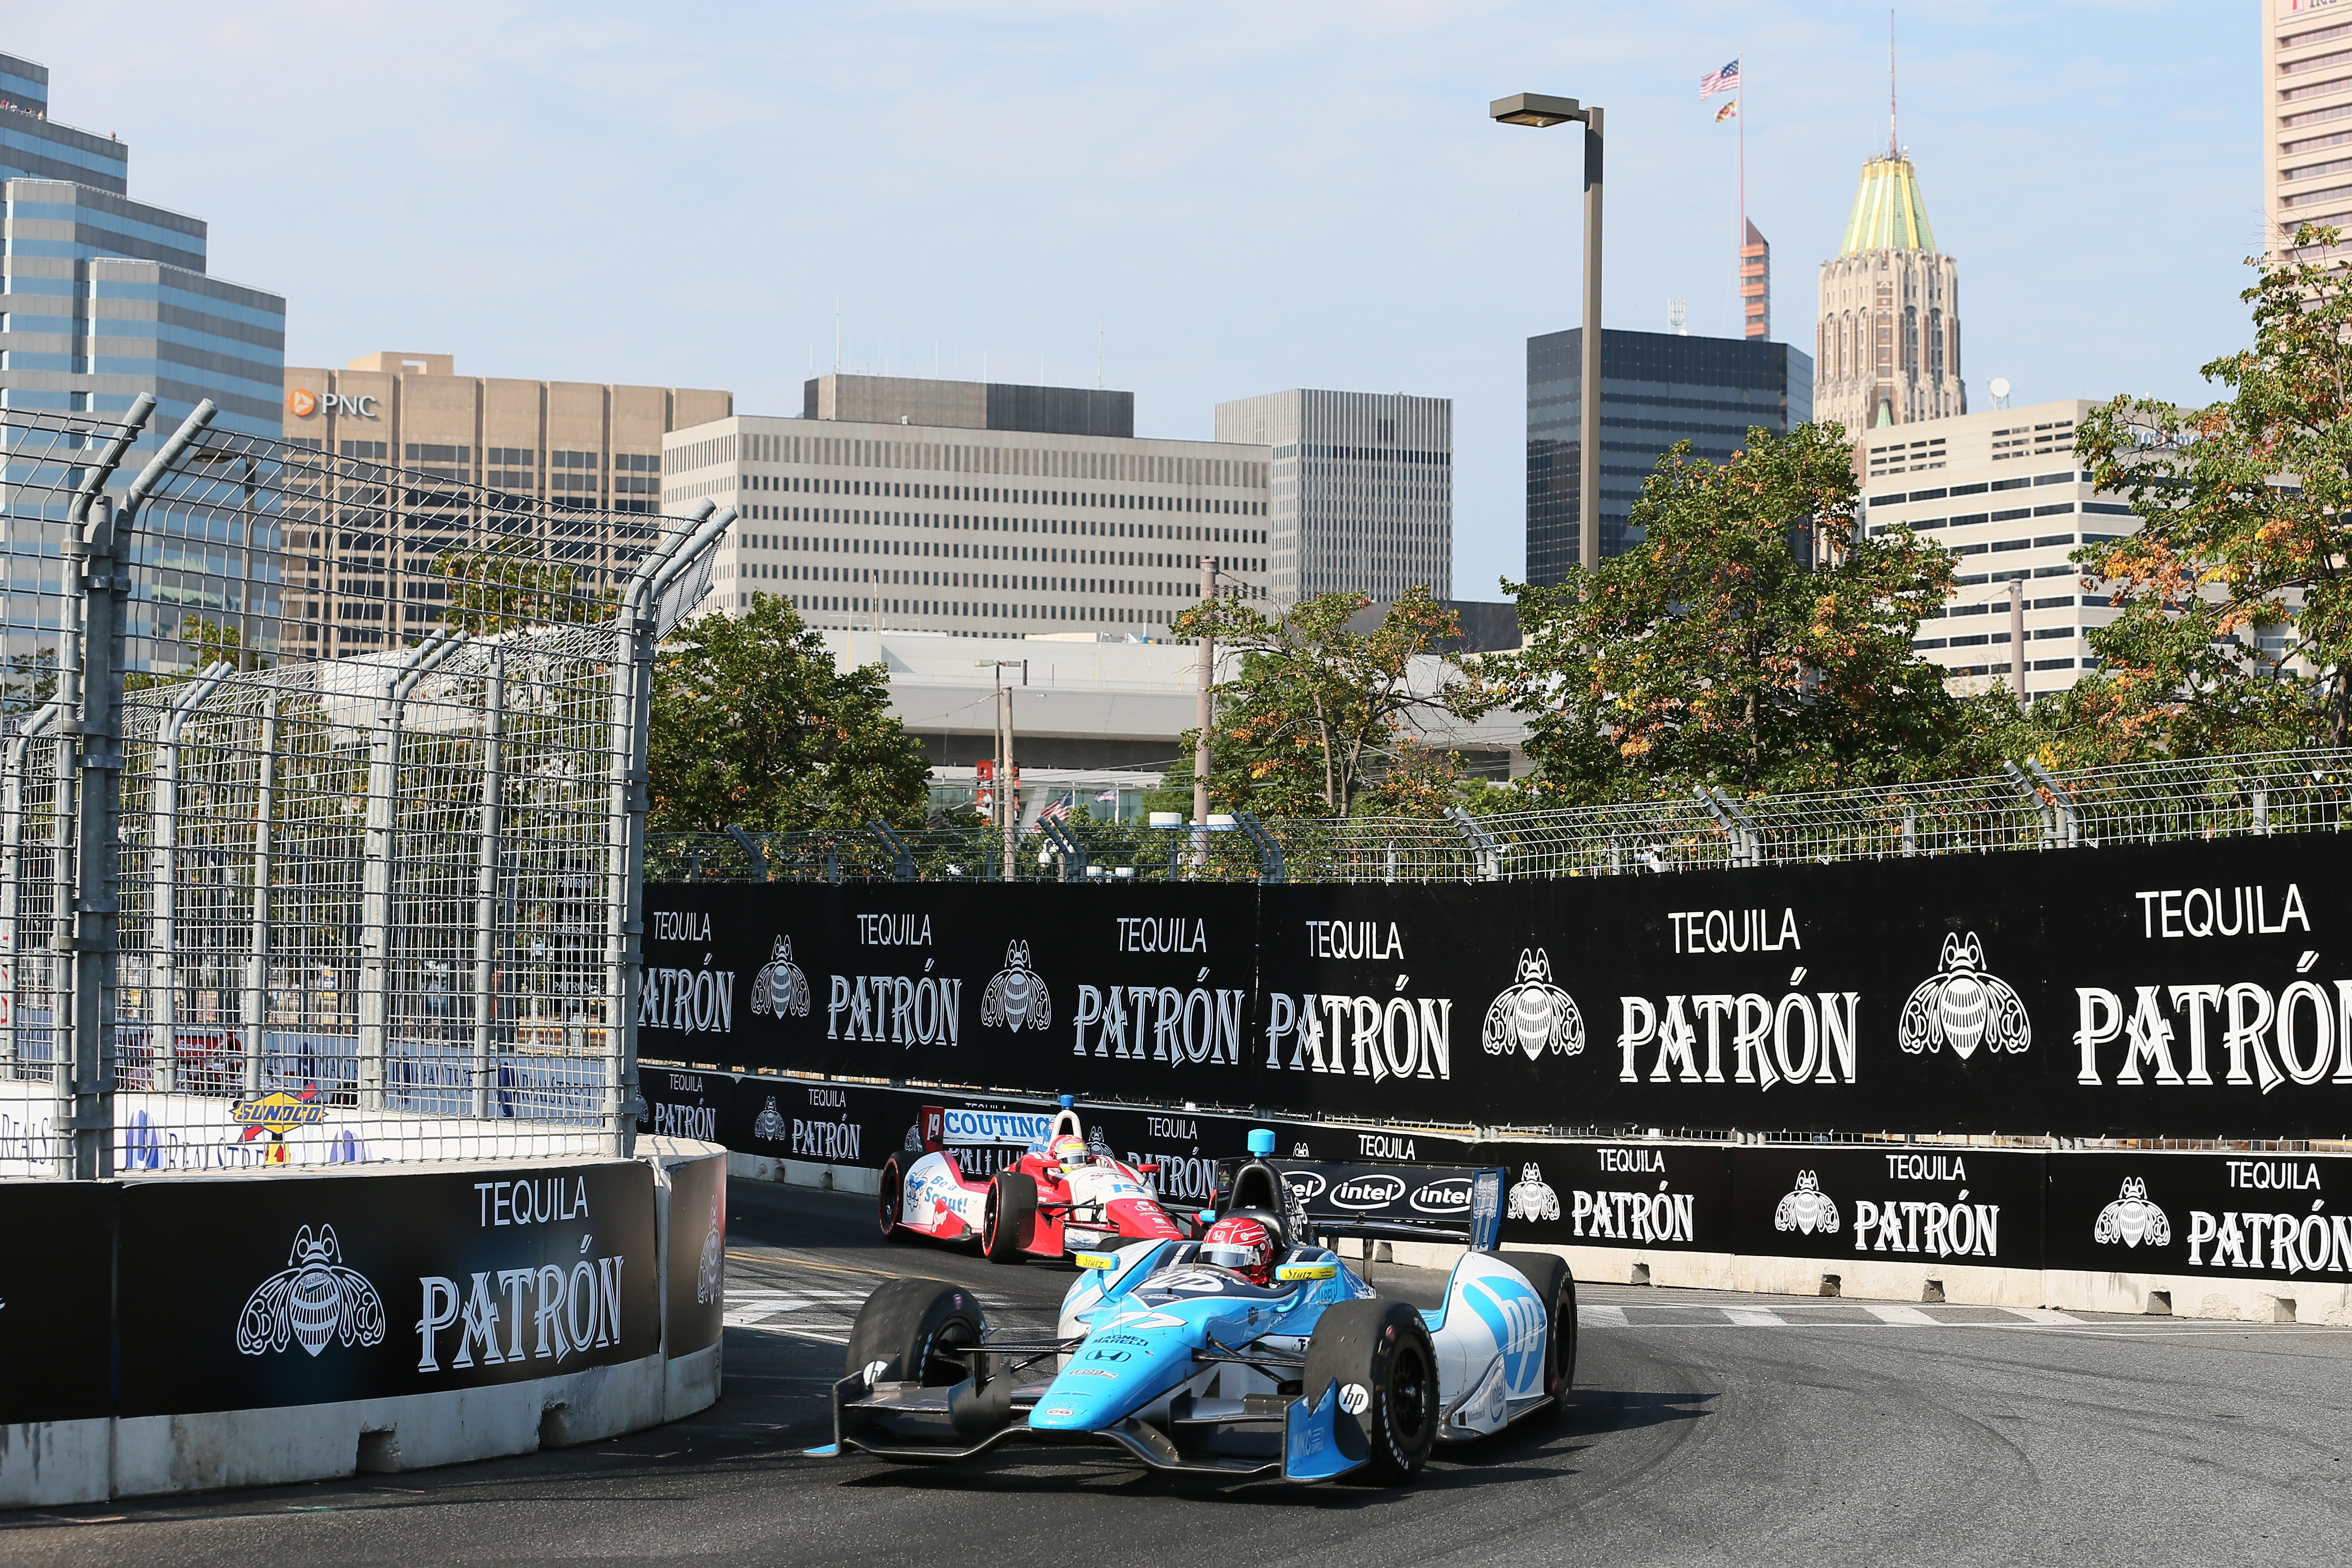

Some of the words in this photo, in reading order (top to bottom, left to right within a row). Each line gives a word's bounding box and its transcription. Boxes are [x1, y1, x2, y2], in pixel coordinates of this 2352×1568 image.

[320, 393, 377, 417] PNC
[2135, 883, 2311, 938] TEQUILA
[555, 926, 590, 936] PATRN
[654, 911, 711, 941] TEQUILA
[857, 913, 932, 946] TEQUILA
[1117, 917, 1207, 952] TEQUILA
[1305, 920, 1404, 960] TEQUILA
[1668, 907, 1801, 953] TEQUILA
[827, 958, 962, 1049] PATRÓN
[1073, 967, 1245, 1068] PATRÓN
[1265, 974, 1453, 1084] PATRÓN
[1617, 966, 1861, 1092] PATRÓN
[669, 1073, 703, 1093] TEQUILA
[808, 1088, 846, 1107] TEQUILA
[238, 1105, 322, 1122] SUNOCO
[654, 1098, 716, 1141] PATRÓN
[927, 1113, 941, 1141] 19
[945, 1112, 1049, 1137] COUTIN
[792, 1113, 861, 1160] PATRÓN
[1147, 1117, 1198, 1140] TEQUILA
[1357, 1133, 1416, 1161] TEQUILA
[1597, 1148, 1666, 1172] TEQUILA
[930, 1176, 948, 1187] Be
[1886, 1154, 1966, 1181] TEQUILA
[2226, 1161, 2321, 1190] TEQUILA
[474, 1176, 589, 1227] TEQUILA
[1340, 1182, 1393, 1201] intel
[1420, 1185, 1472, 1205] intel
[1572, 1180, 1695, 1244] PATRÓN
[1853, 1189, 2000, 1259] PATRÓN
[2187, 1199, 2352, 1275] PATRÓN
[1083, 1255, 1104, 1269] Stutz
[1285, 1268, 1313, 1279] Stutz
[415, 1234, 625, 1373] PATRÓN
[1092, 1338, 1149, 1347] MARELLI
[1341, 1383, 1366, 1415] hp
